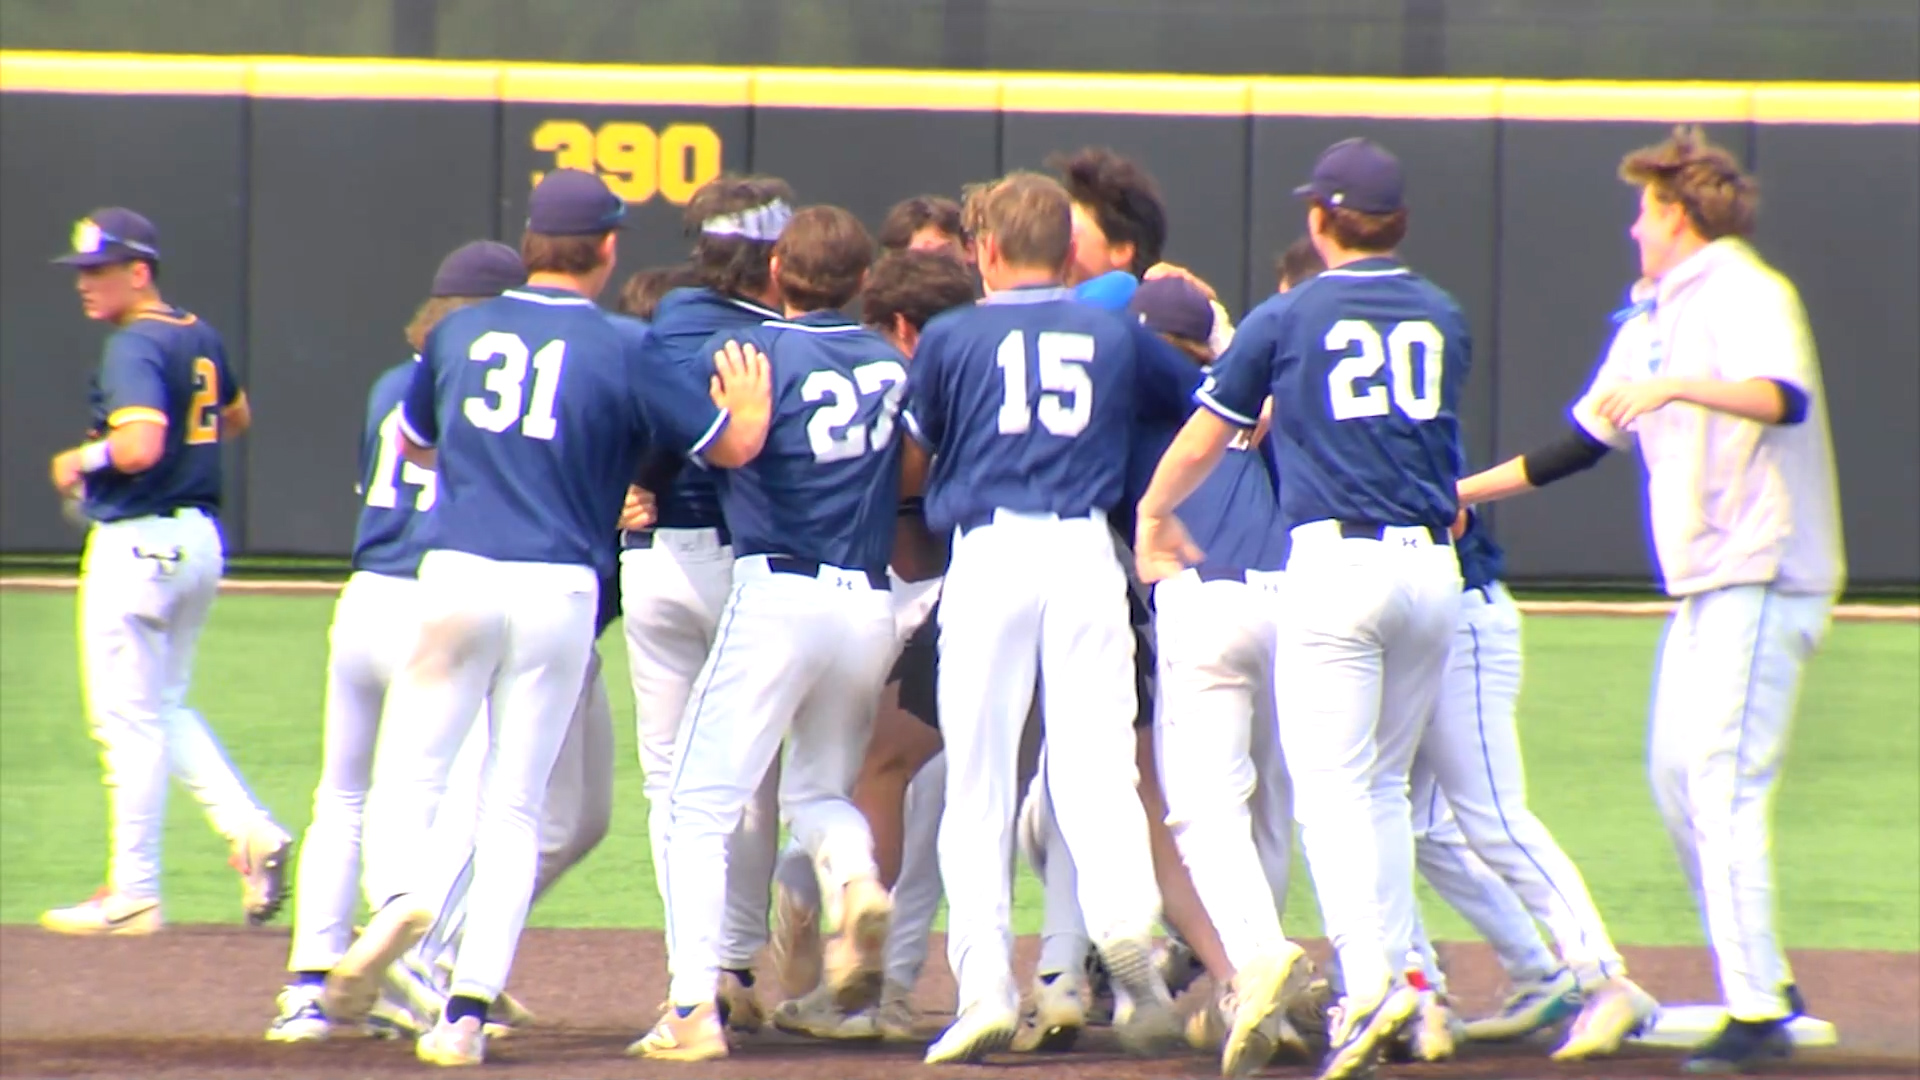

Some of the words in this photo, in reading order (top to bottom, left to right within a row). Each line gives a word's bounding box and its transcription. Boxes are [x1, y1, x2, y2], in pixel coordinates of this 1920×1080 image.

[532, 119, 722, 205] 390
[185, 357, 219, 445] 2
[463, 331, 567, 440] 31
[800, 360, 907, 463] 27
[997, 329, 1095, 437] 15
[1324, 319, 1445, 421] 20
